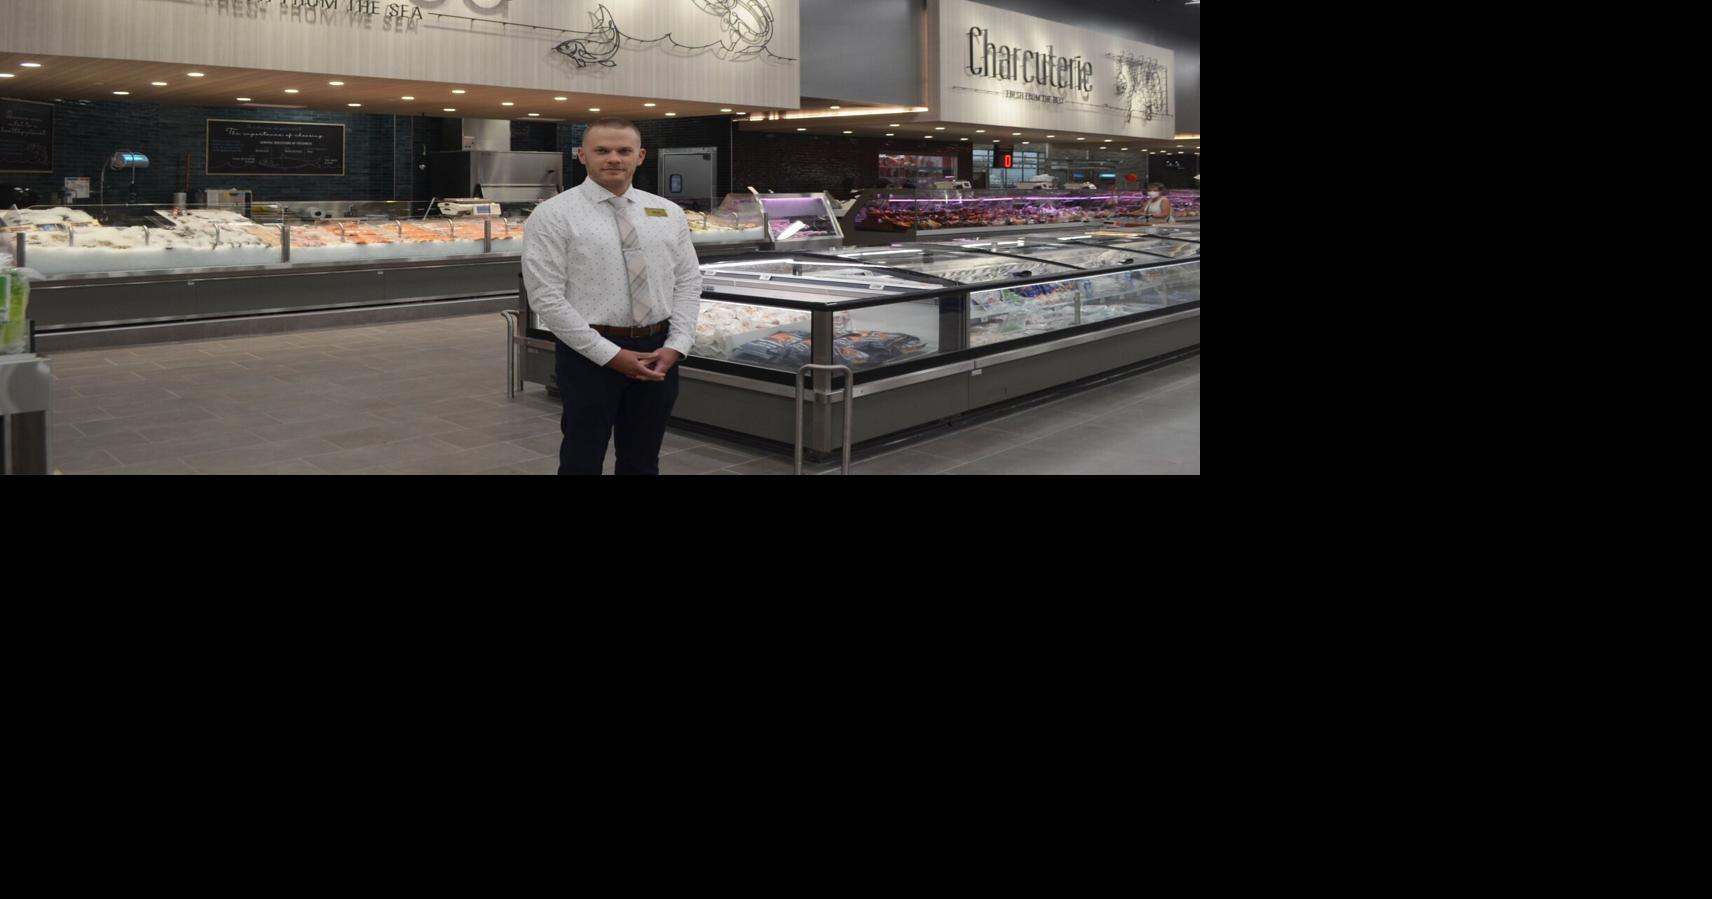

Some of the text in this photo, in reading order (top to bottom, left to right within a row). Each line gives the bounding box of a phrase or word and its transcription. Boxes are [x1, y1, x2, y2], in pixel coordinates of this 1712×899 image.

[389, 3, 423, 20] SEA
[968, 26, 1094, 93] Charcuterie
[1004, 154, 1012, 168] 0
